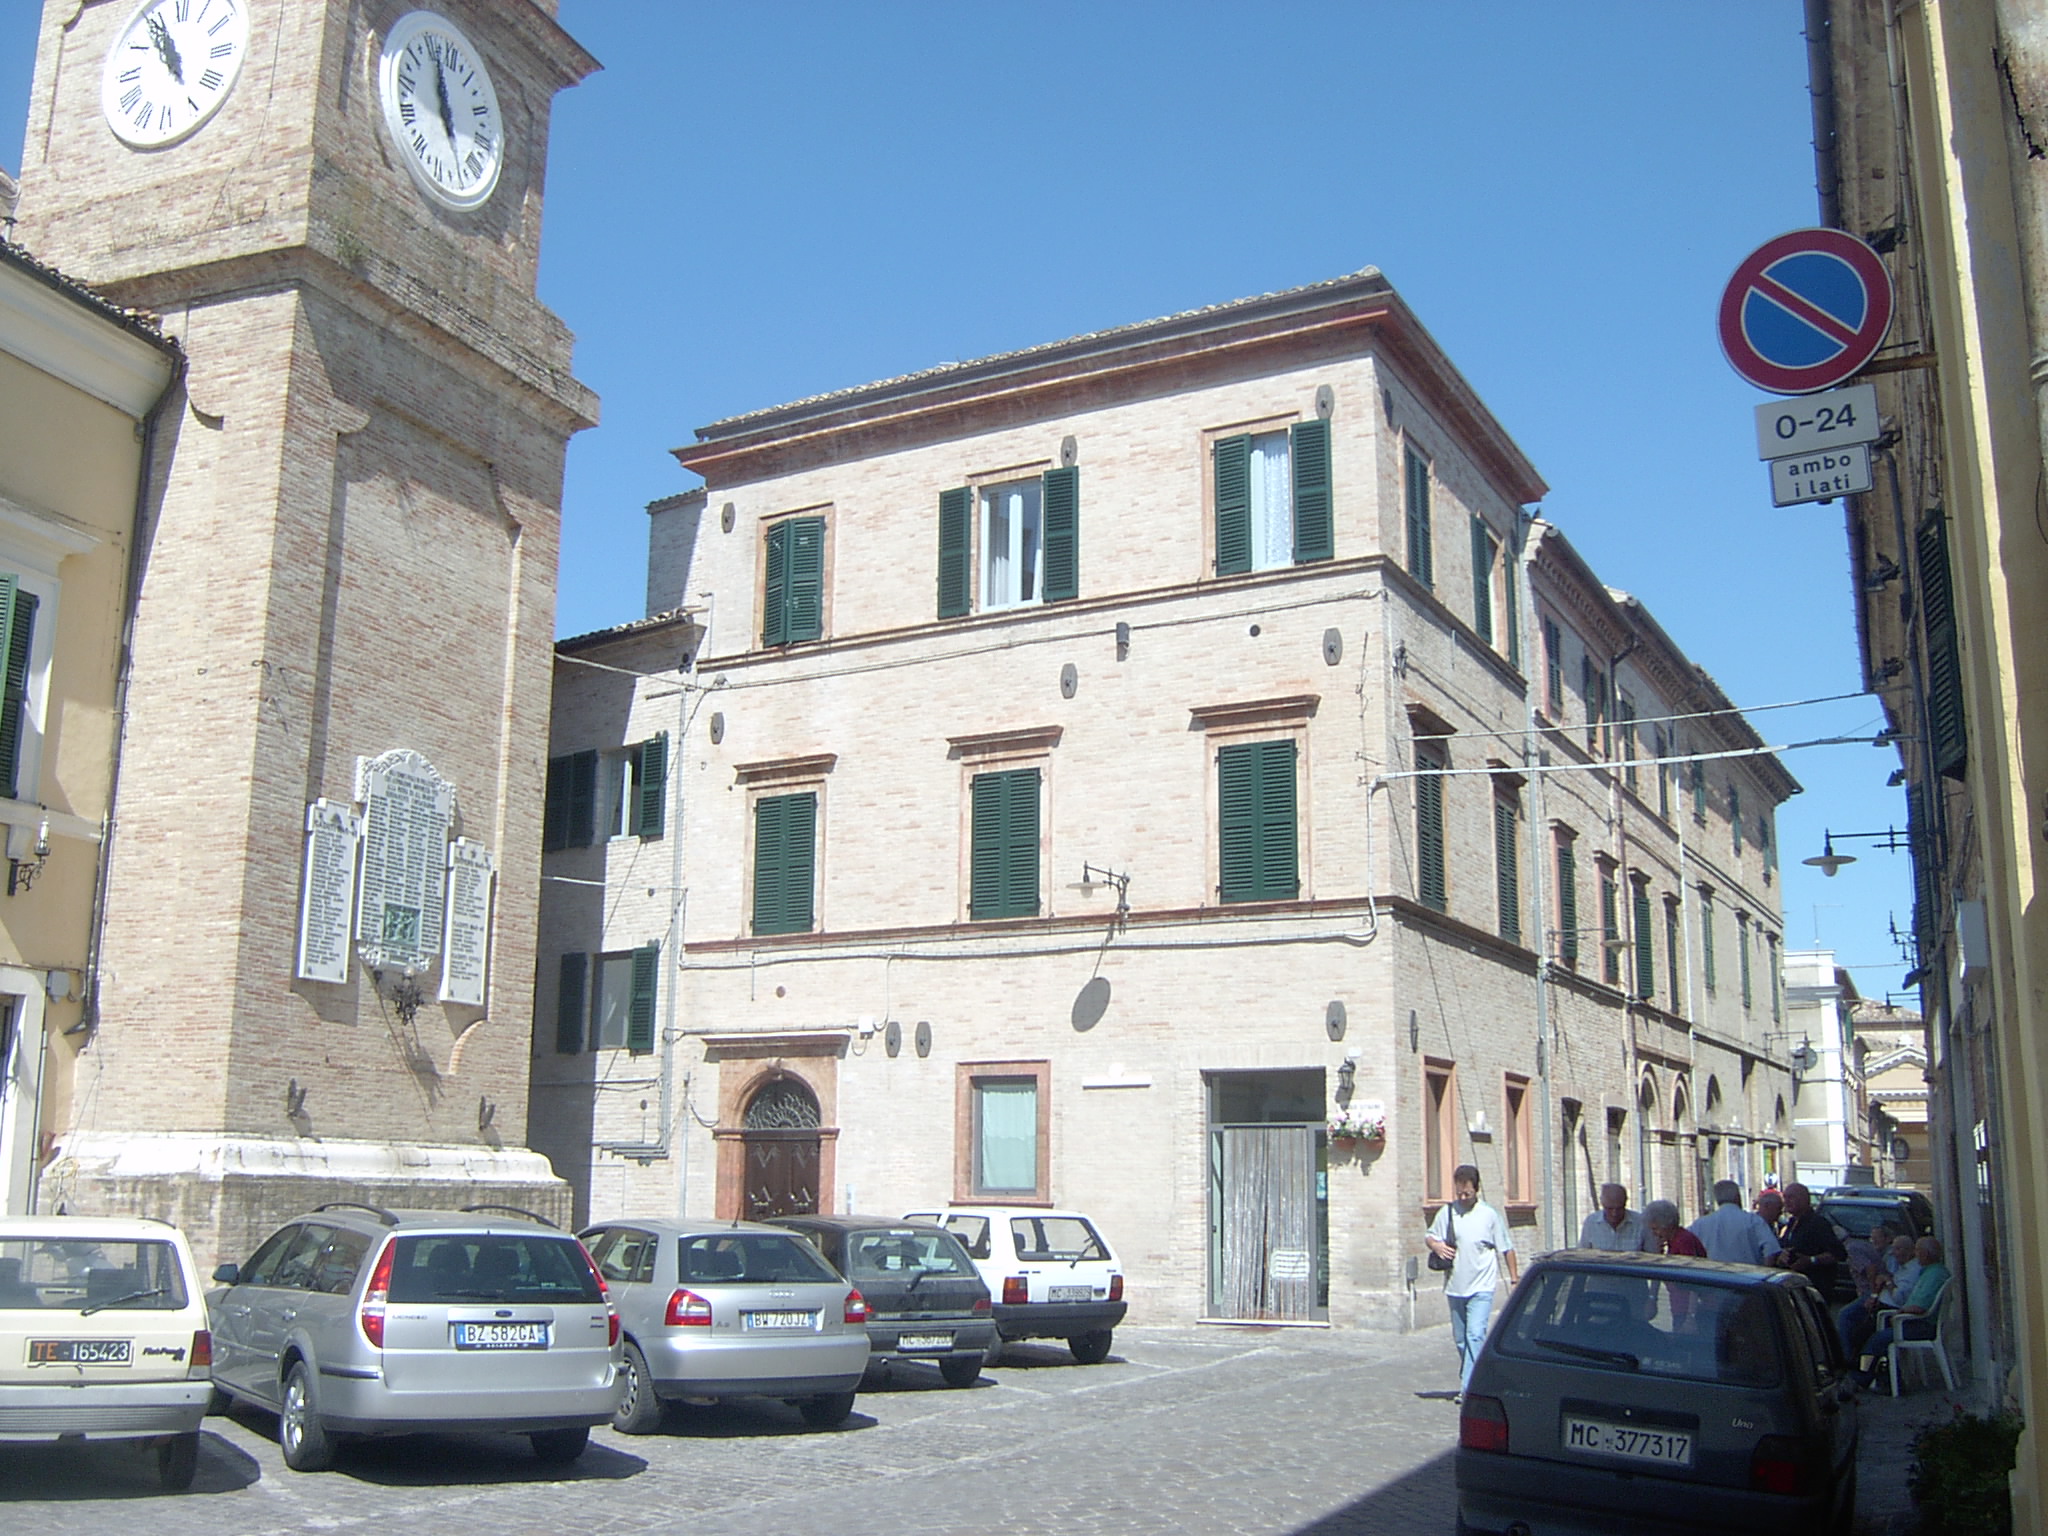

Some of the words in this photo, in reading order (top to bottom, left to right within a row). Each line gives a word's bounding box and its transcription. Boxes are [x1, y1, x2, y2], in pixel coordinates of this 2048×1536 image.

[1788, 455, 1852, 476] ambo
[1794, 482, 1801, 498] i
[1809, 473, 1850, 495] lati
[467, 1325, 489, 1342] BZ
[34, 1342, 59, 1361] TE
[72, 1342, 129, 1361] 165423
[1731, 1417, 1754, 1430] Uno
[1570, 1422, 1600, 1447] MC
[1614, 1428, 1689, 1462] 377317
